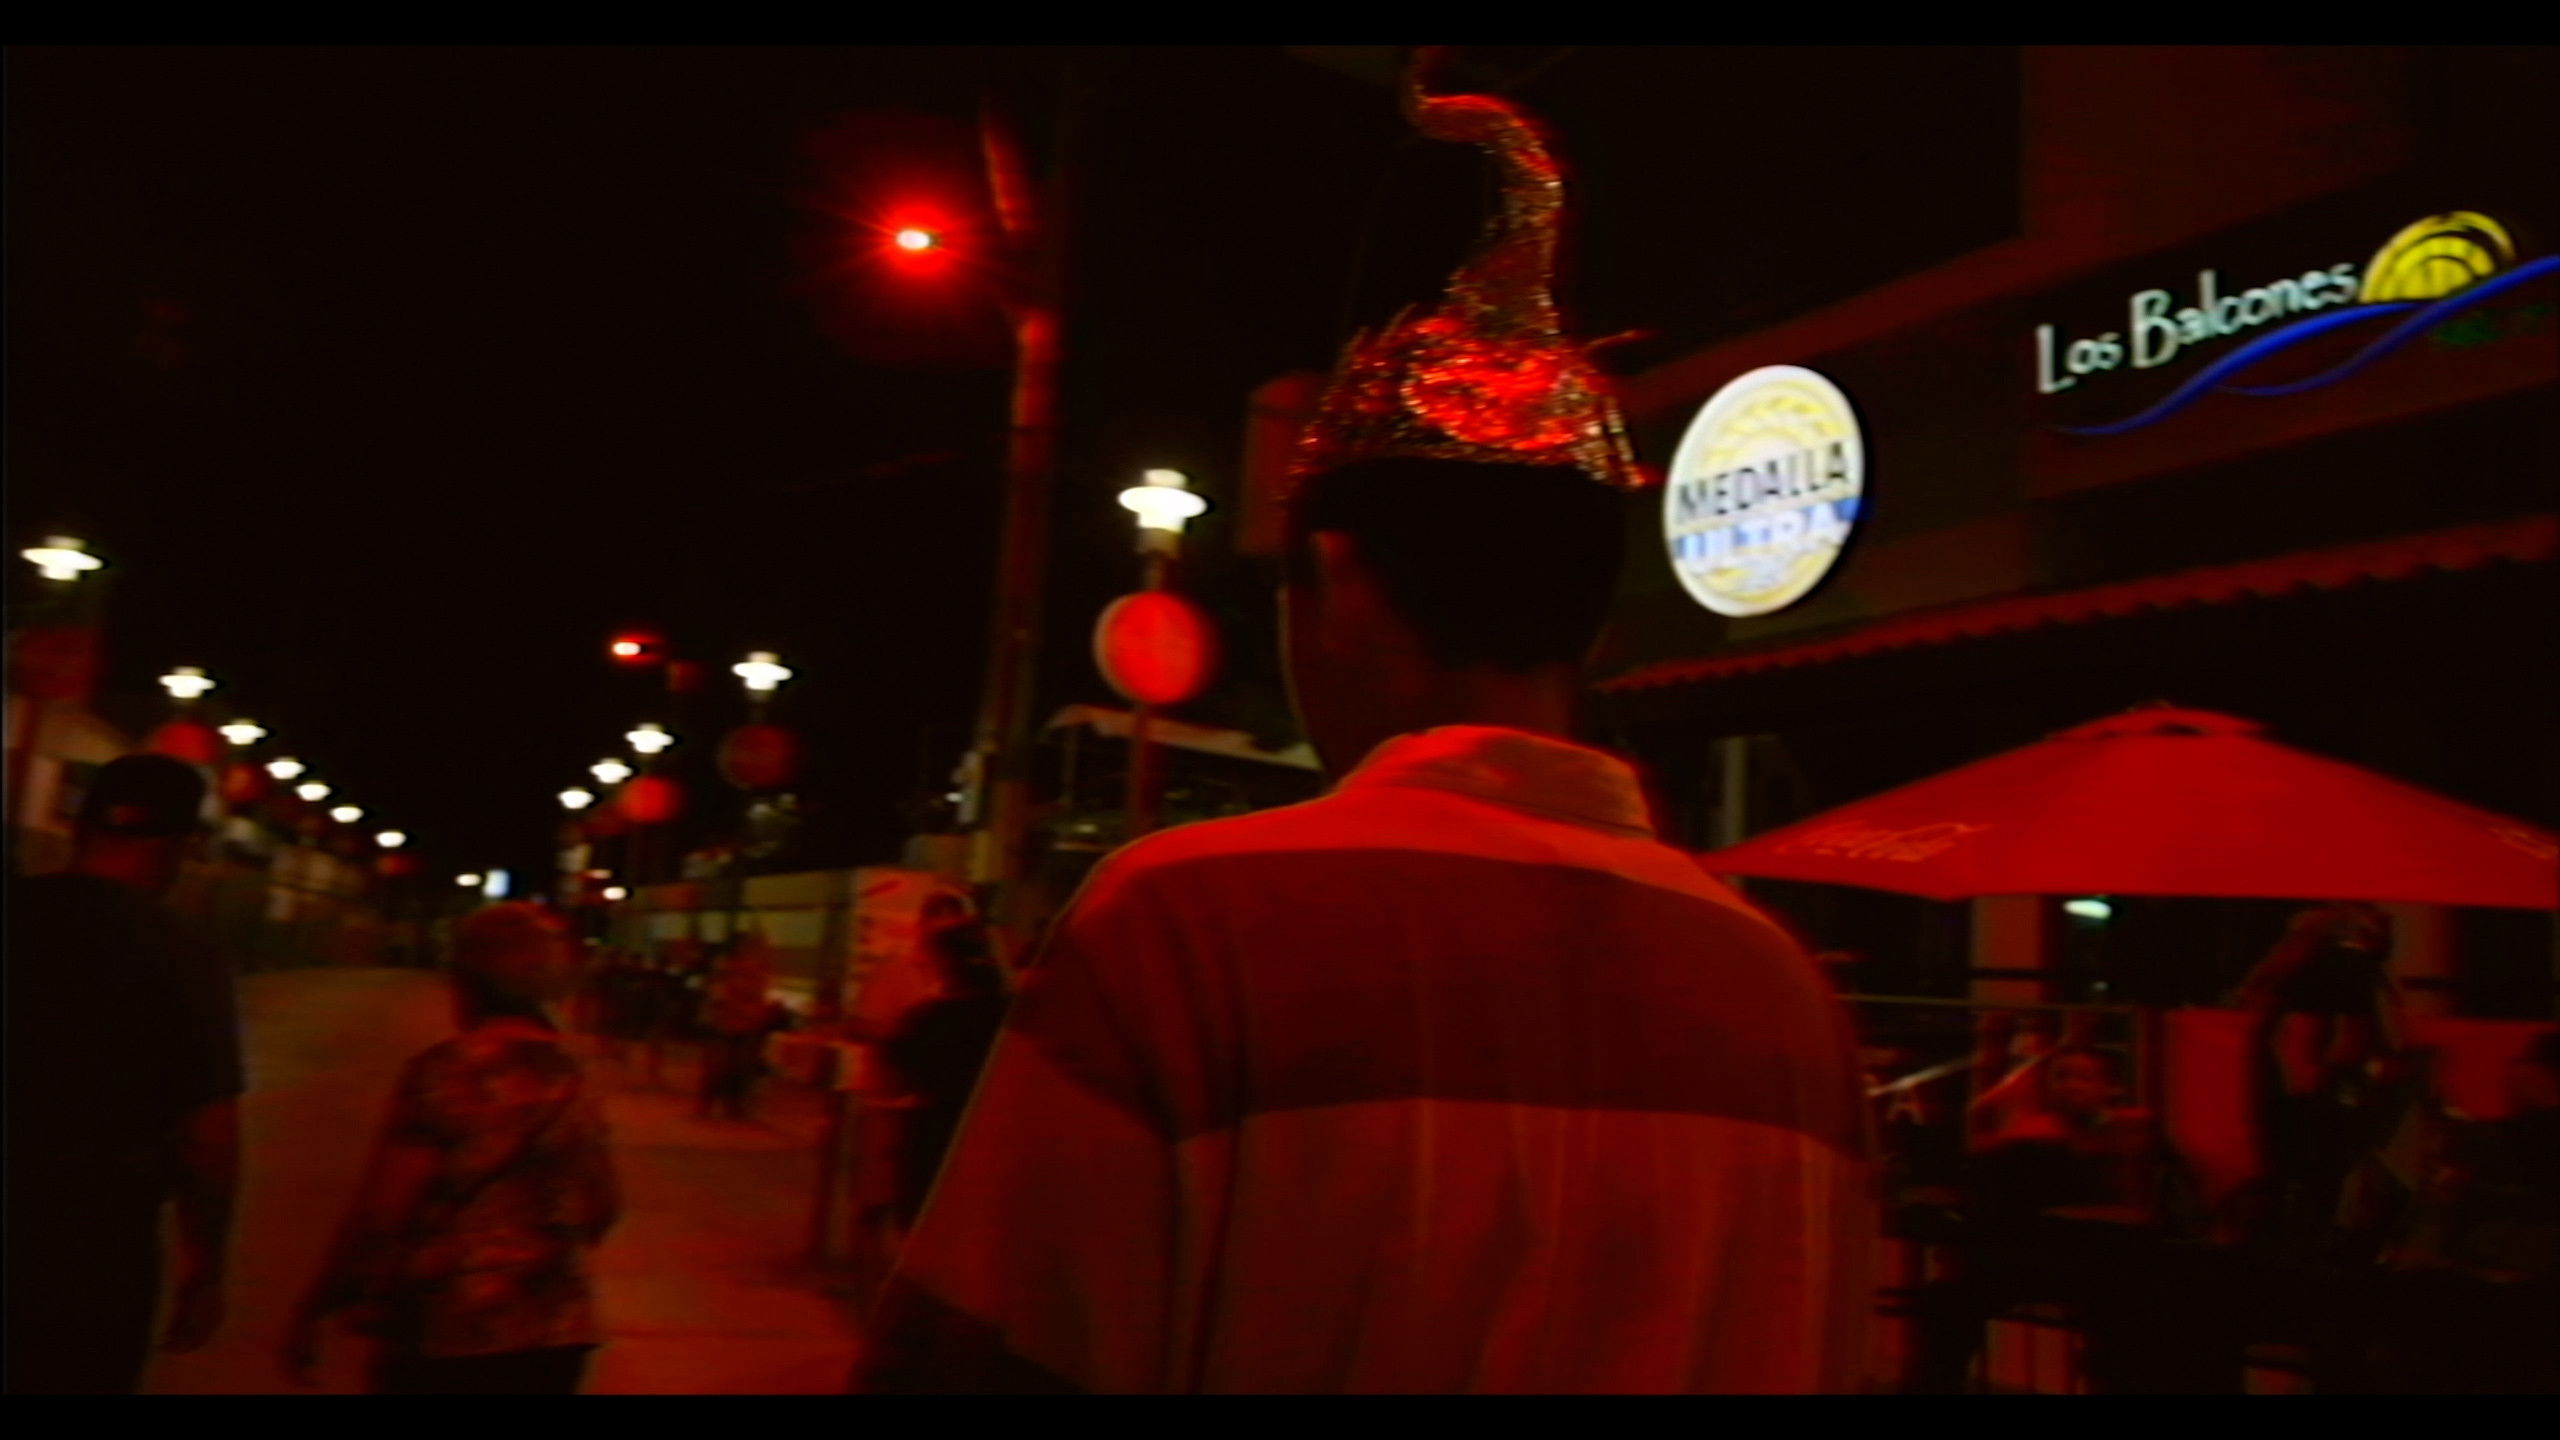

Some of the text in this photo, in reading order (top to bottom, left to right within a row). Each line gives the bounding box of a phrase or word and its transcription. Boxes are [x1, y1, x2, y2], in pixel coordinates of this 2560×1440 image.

[2036, 263, 2359, 394] Los Balcones
[1676, 441, 1848, 525] MEDALLA
